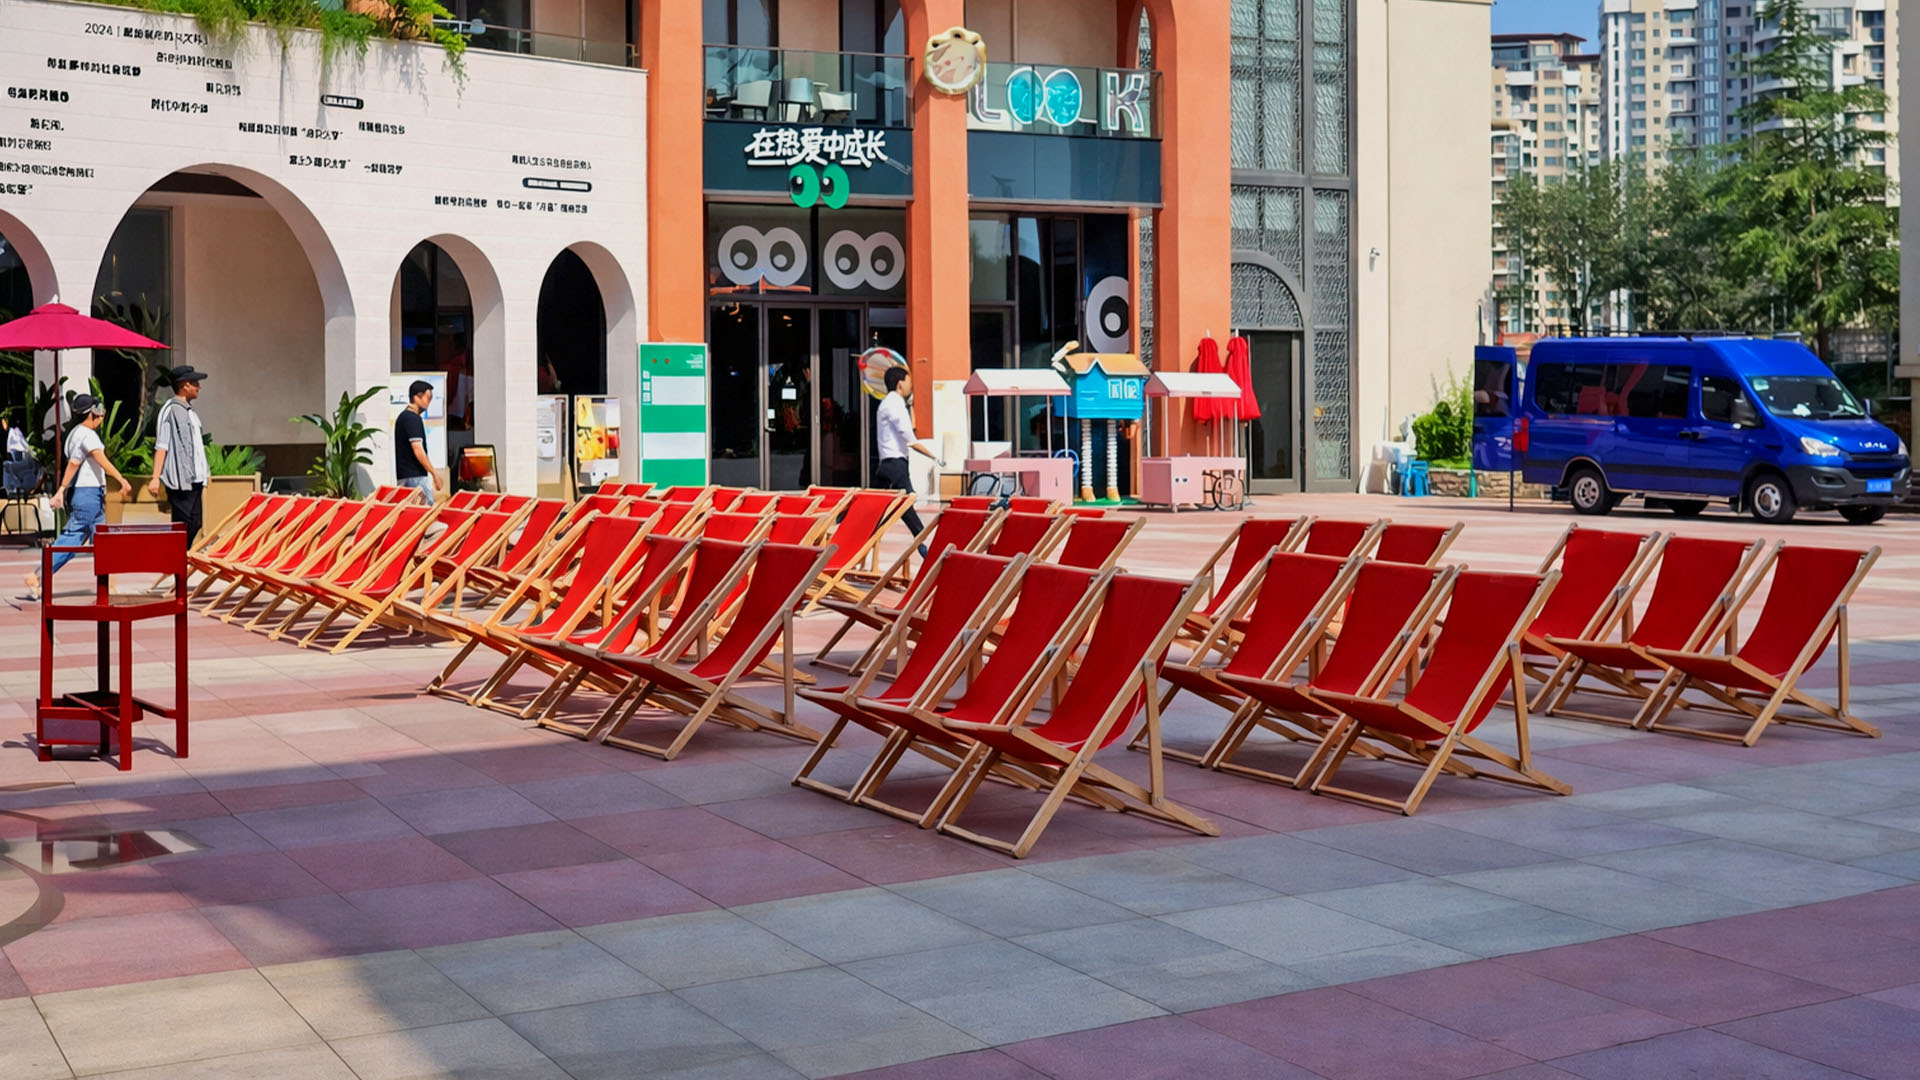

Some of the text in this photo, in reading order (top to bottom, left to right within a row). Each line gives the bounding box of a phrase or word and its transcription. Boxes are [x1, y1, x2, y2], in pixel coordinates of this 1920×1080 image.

[744, 127, 889, 168] 在热爱中成长
